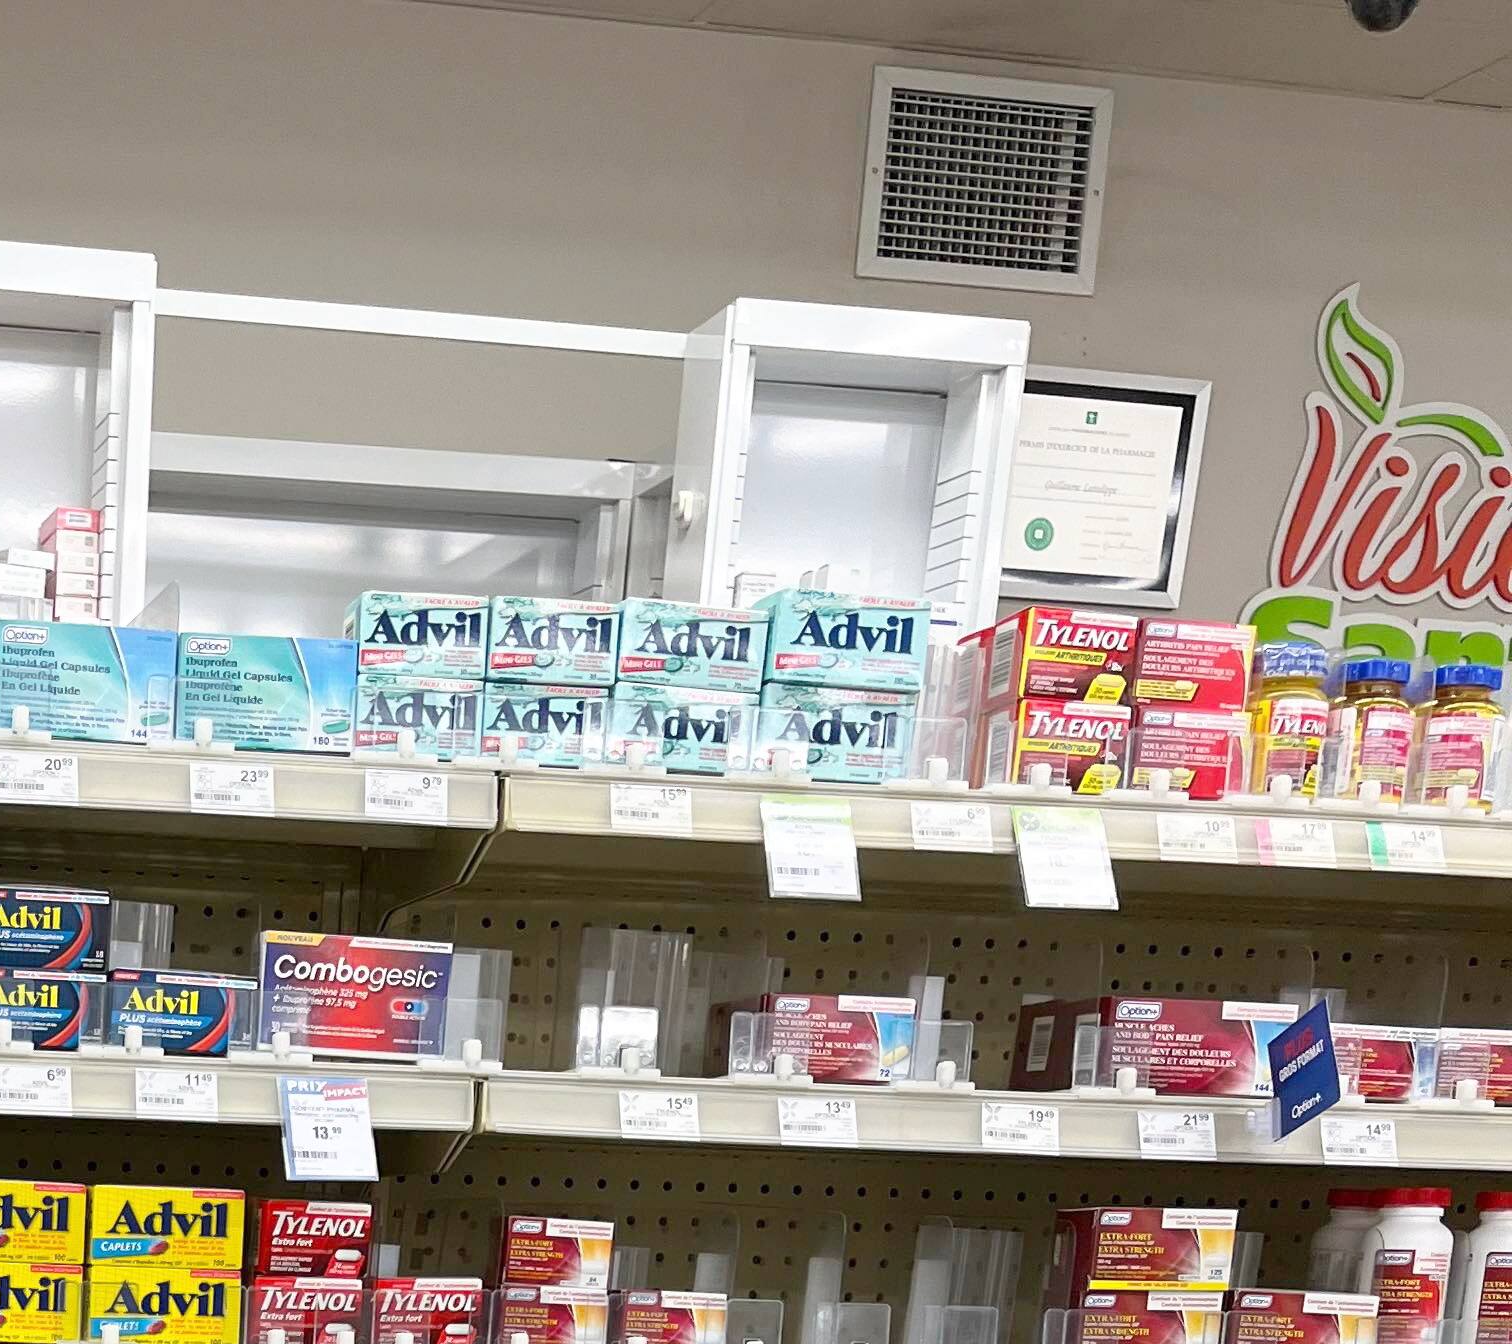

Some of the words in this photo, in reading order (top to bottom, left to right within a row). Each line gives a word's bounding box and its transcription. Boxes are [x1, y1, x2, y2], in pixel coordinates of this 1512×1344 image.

[1280, 405, 1512, 605] Visi
[364, 609, 482, 647] Advil
[495, 613, 613, 653] Advil
[790, 609, 914, 654] Advil
[1036, 618, 1130, 652] TYLENOL
[636, 619, 751, 663] Advil
[1, 645, 56, 659] Ibuprofen
[0, 657, 36, 671] Liquid
[39, 659, 58, 671] Gel
[59, 662, 111, 675] Capsules
[1, 681, 16, 692] En
[18, 683, 38, 694] Gel
[130, 728, 148, 739] 144
[1028, 710, 1124, 741] TYLENOL
[274, 954, 438, 992] Combogesic
[122, 986, 199, 1015] Advil
[343, 1000, 356, 1009] mg
[1155, 1033, 1174, 1041] PAIN
[1175, 1034, 1204, 1042] RELIEF
[1166, 1057, 1177, 1065] ET
[1179, 1057, 1236, 1067] CORPORELLES
[1172, 1048, 1188, 1056] DES
[1190, 1049, 1231, 1058] DOULEURS
[287, 1079, 328, 1094] PRIX
[322, 1084, 368, 1099] IMPACT
[107, 1200, 229, 1239] Advil
[271, 1209, 367, 1239] TYLENOL
[100, 1240, 142, 1253] CAPLETS
[272, 1237, 295, 1247] Extra
[296, 1239, 315, 1248] fort
[379, 1289, 478, 1314] TYLENOL
[379, 1313, 404, 1323] Extra
[406, 1314, 423, 1324] fort
